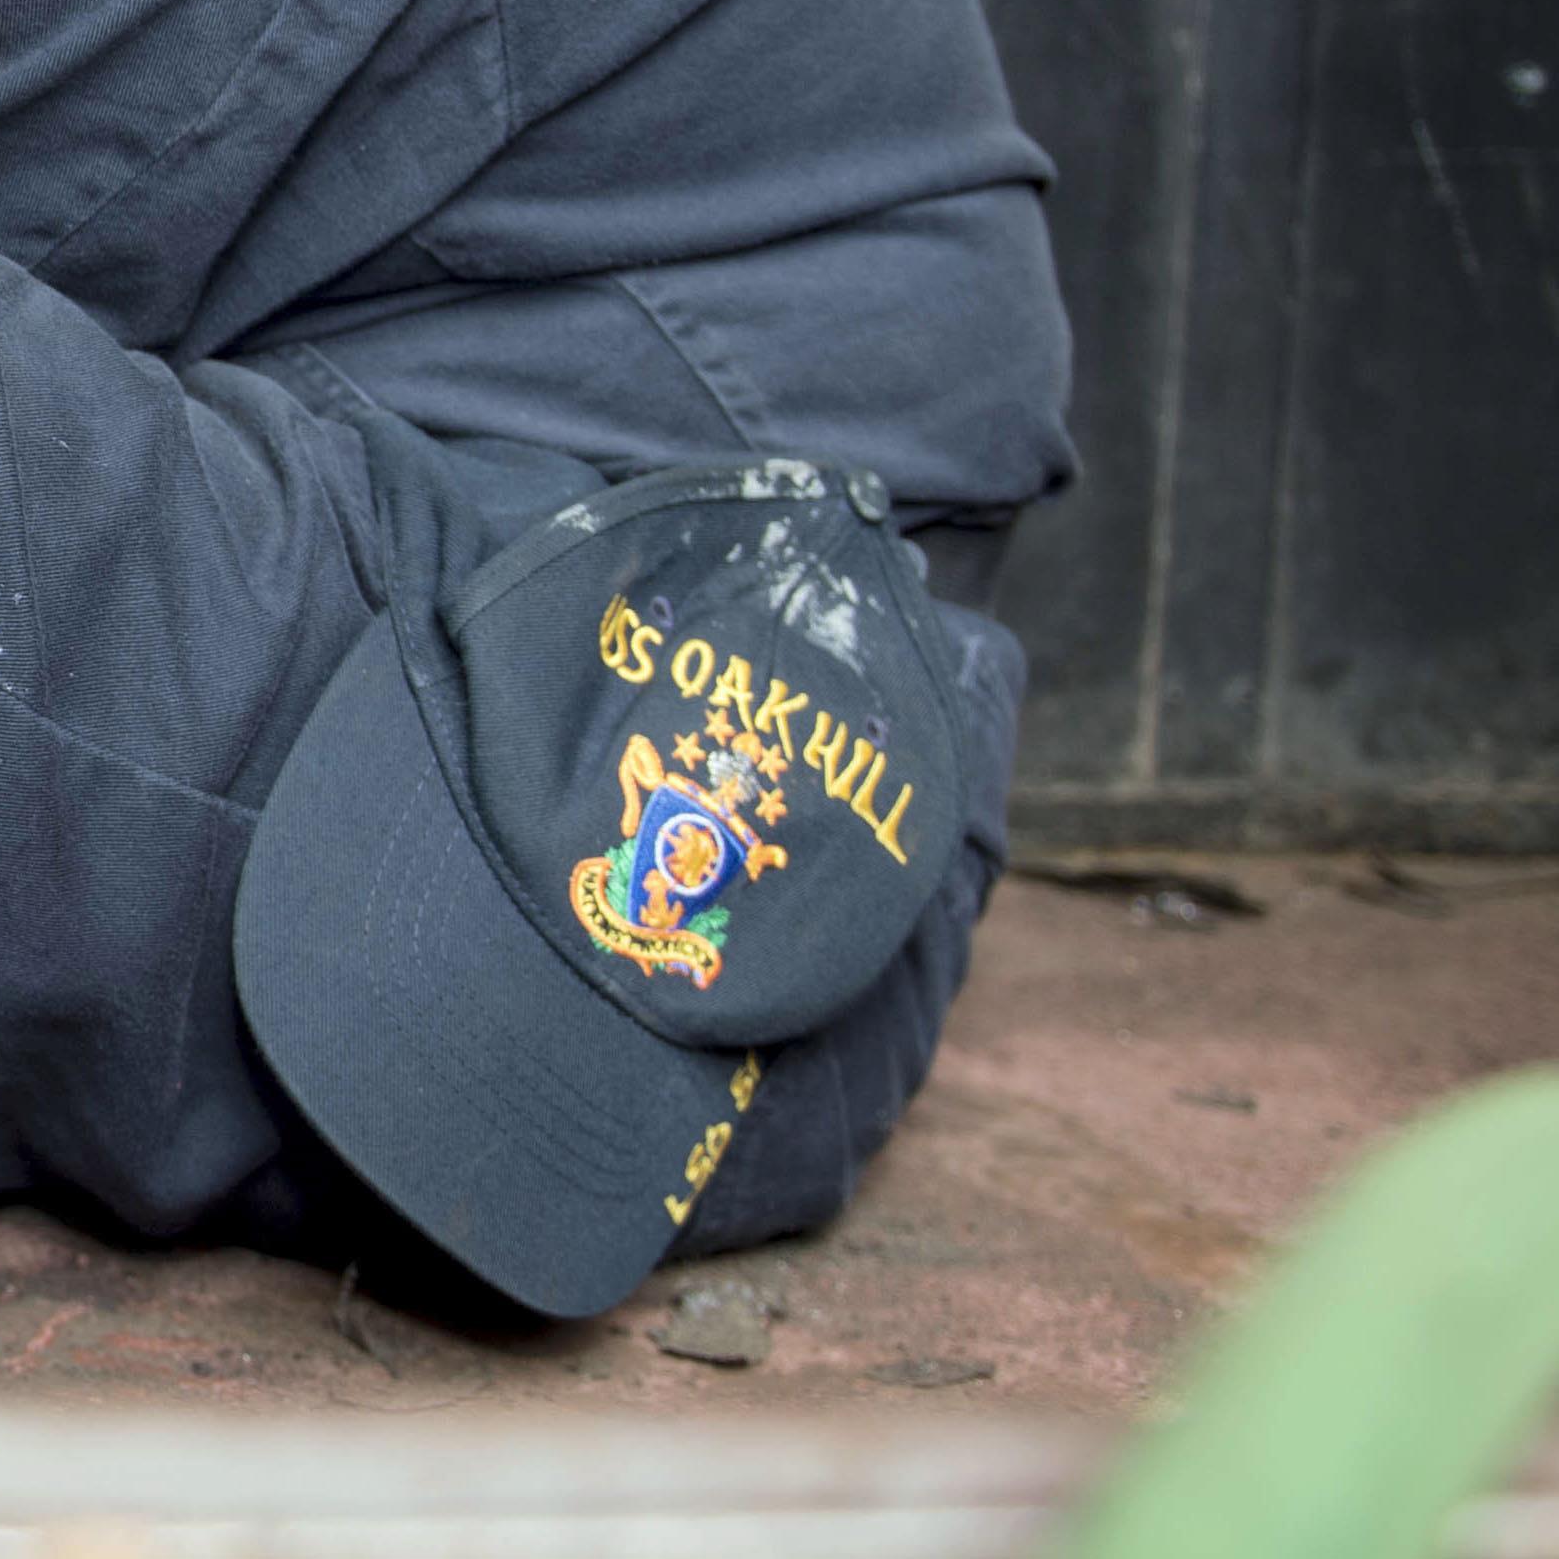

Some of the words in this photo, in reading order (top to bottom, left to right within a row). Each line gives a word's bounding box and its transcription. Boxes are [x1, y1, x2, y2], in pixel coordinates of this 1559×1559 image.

[599, 592, 663, 684] USS
[671, 639, 809, 761] OAK
[804, 711, 914, 866] HILL
